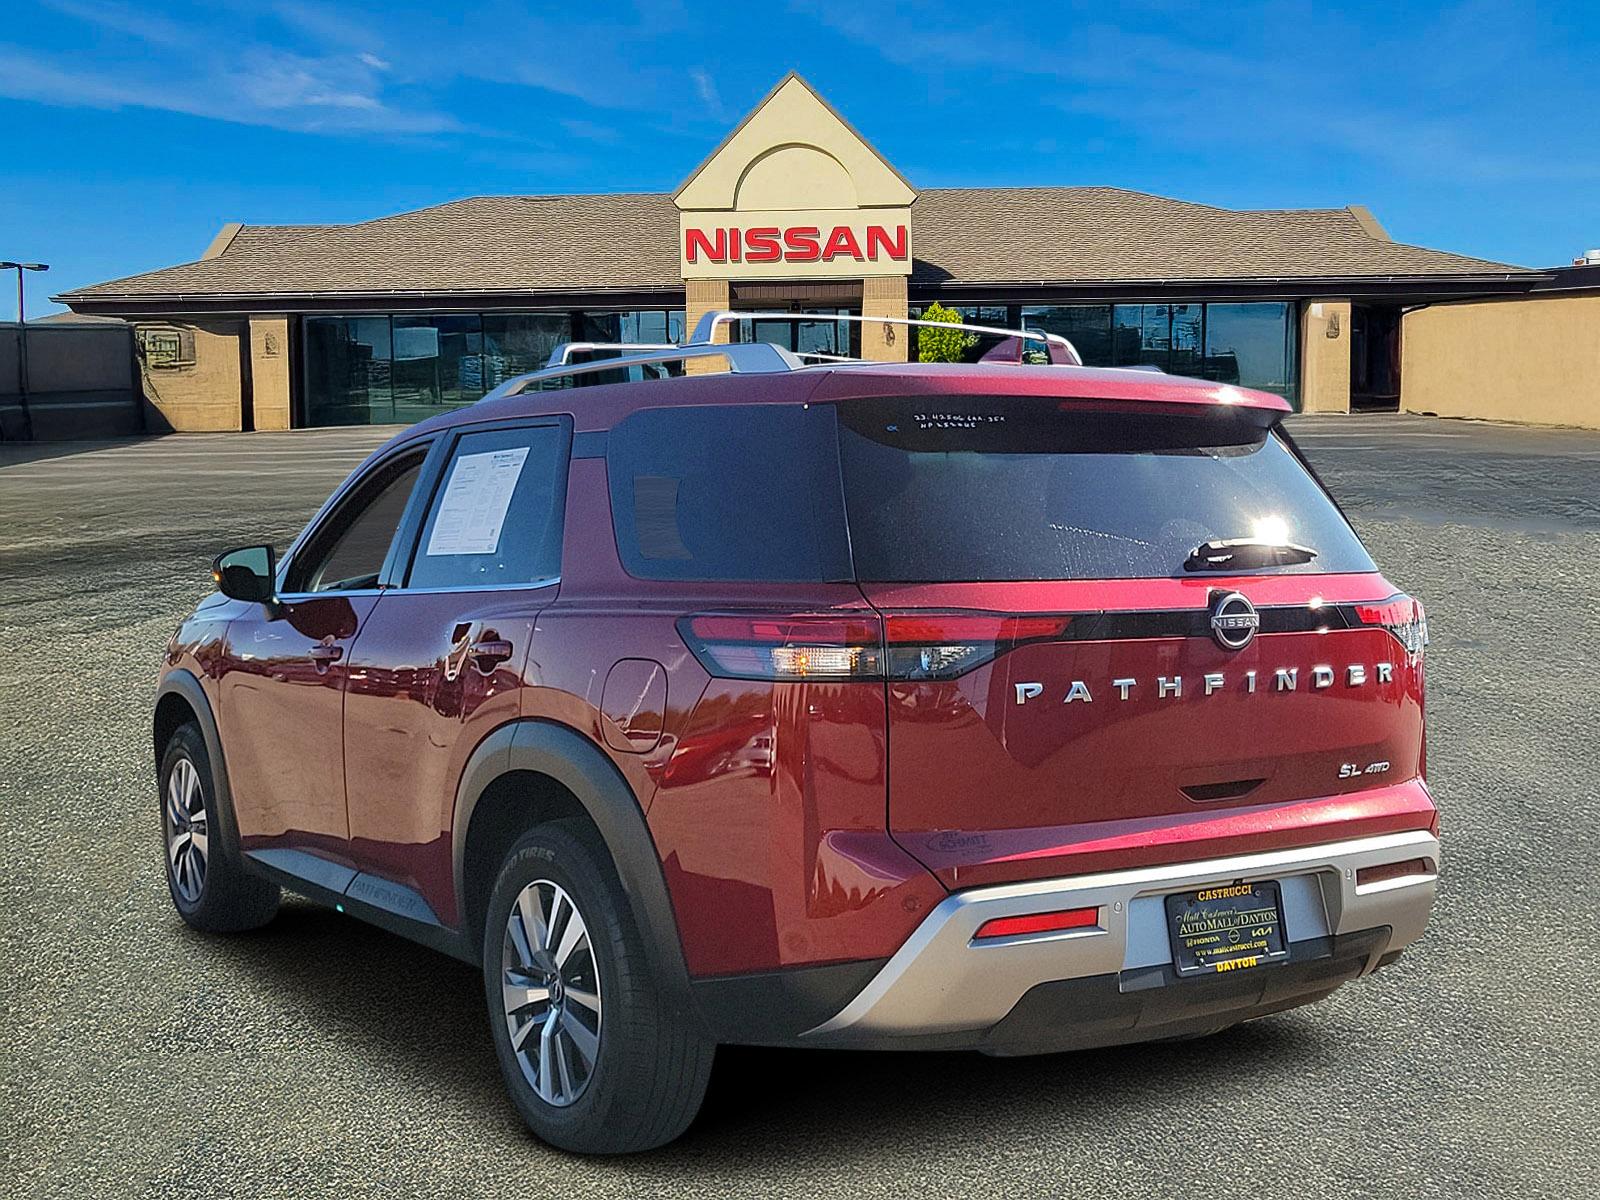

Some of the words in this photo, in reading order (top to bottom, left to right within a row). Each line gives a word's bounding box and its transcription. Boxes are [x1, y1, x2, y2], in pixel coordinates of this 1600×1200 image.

[685, 225, 907, 264] NISSAN
[1212, 617, 1259, 628] NISSAN
[1015, 662, 1393, 705] PATHFINDER
[1338, 763, 1362, 779] SL
[519, 846, 556, 862] TIRES
[1197, 885, 1252, 901] CASTRUCCI
[1176, 910, 1200, 923] Matt
[1193, 935, 1220, 946] HONDA
[1251, 926, 1273, 938] KIA
[1216, 957, 1257, 973] DAYTON
